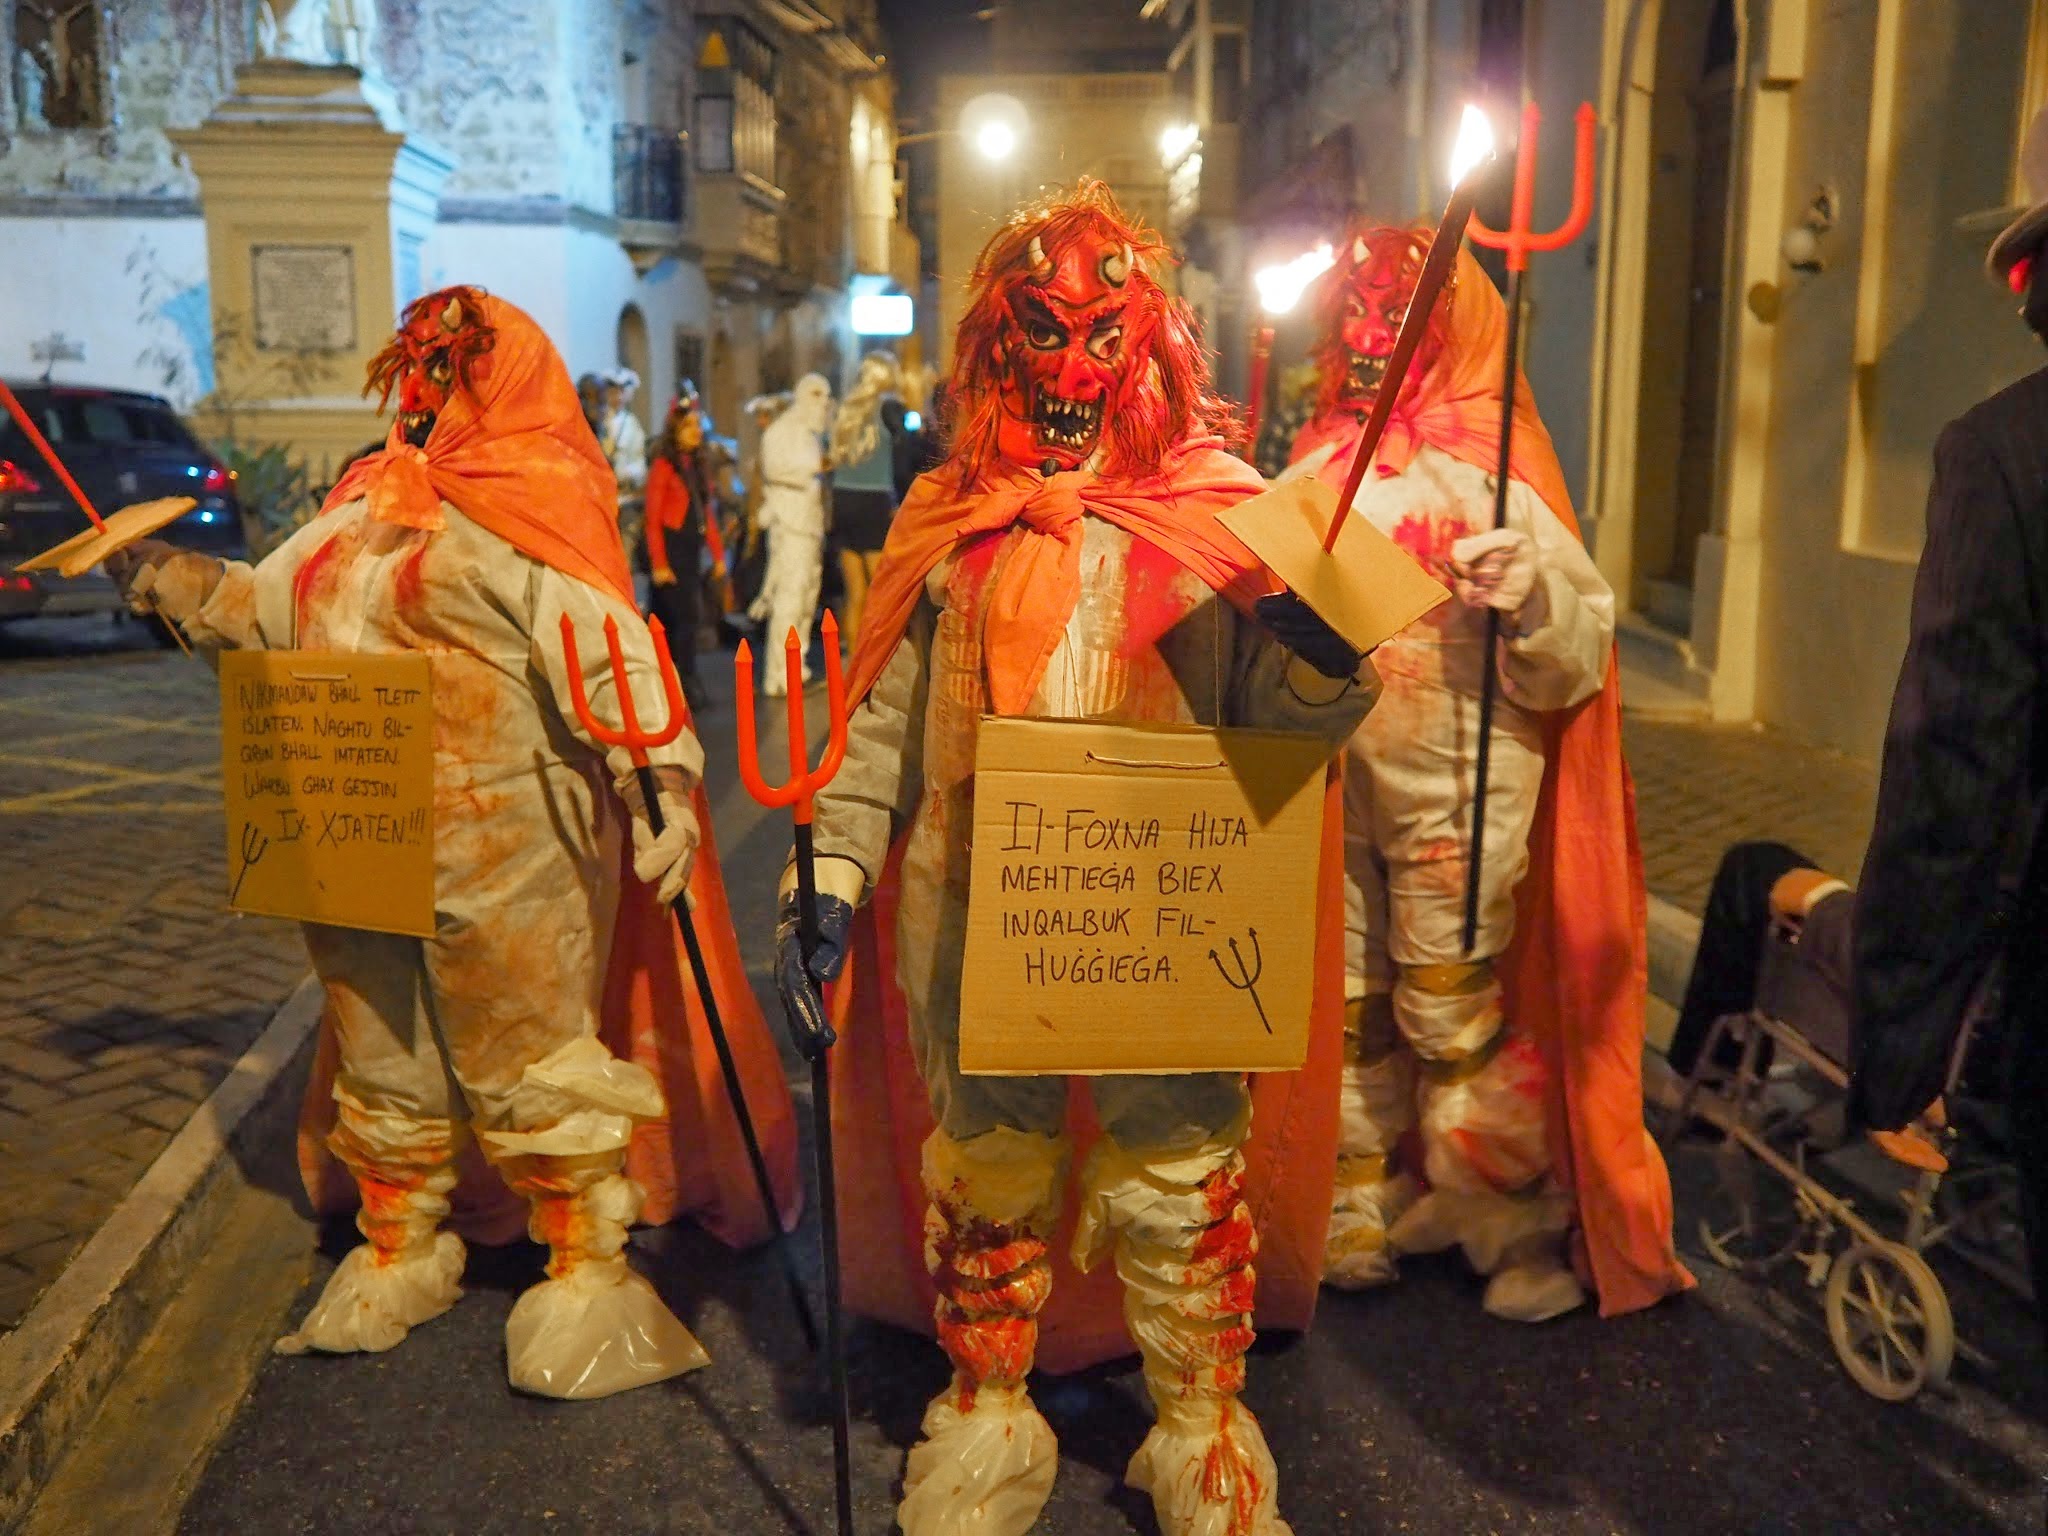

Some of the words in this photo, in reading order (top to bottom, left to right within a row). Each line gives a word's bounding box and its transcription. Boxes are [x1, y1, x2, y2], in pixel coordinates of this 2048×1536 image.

[373, 687, 421, 706] TLETT
[242, 714, 304, 735] ISLATEN.
[313, 711, 372, 738] NAGHTU
[383, 716, 413, 739] BIL-
[302, 774, 335, 796] GHAX
[342, 777, 398, 799] GEJJIN
[1189, 810, 1248, 850] HIJA
[1001, 861, 1136, 894] MEHTIEĠA
[1157, 861, 1224, 895] BIEX
[1003, 907, 1131, 938] INQALBUK
[1156, 907, 1217, 937] FIL-
[1025, 946, 1179, 987] HUĠĠIEĠA.
